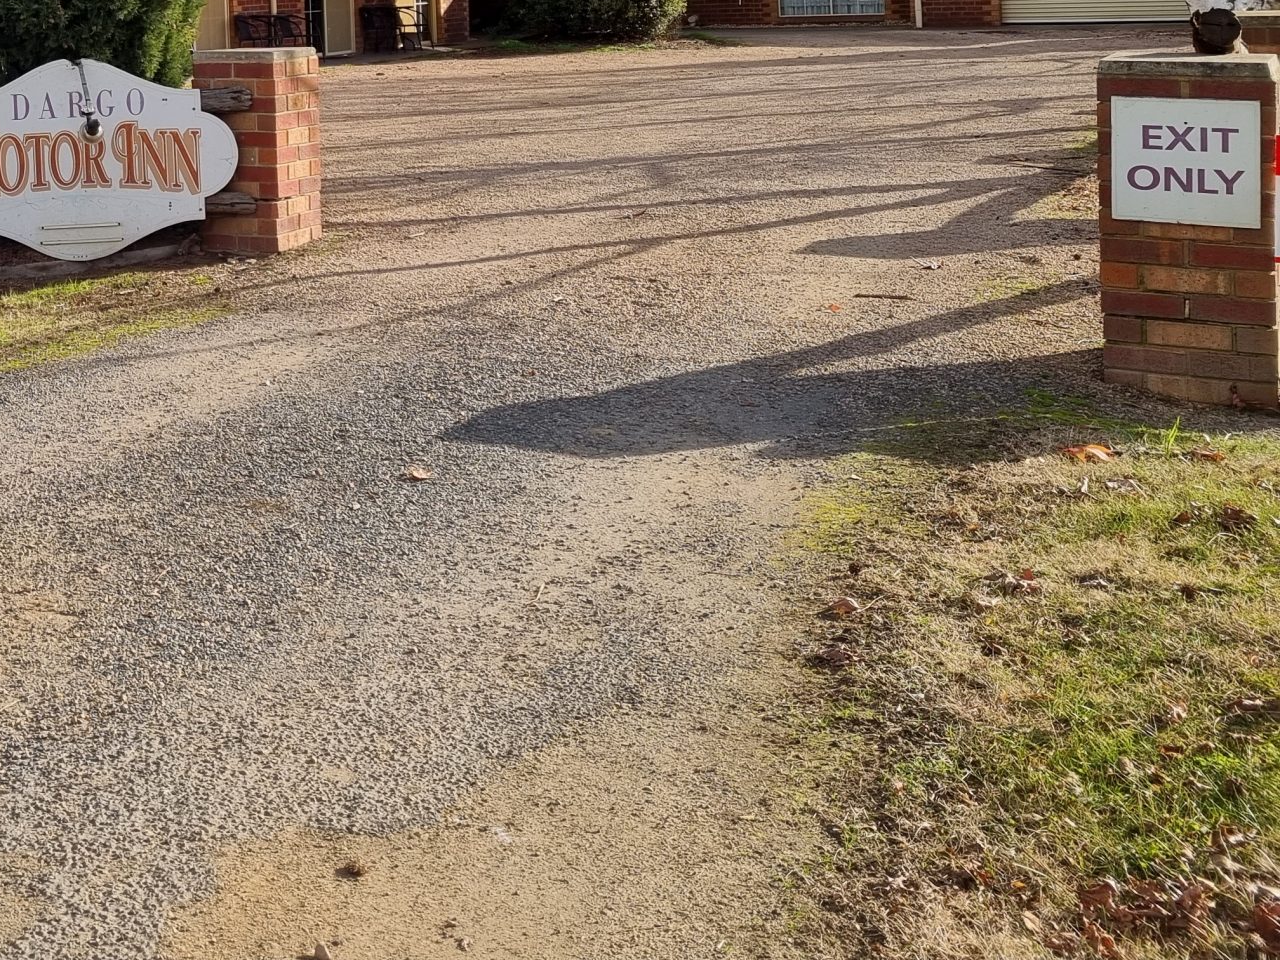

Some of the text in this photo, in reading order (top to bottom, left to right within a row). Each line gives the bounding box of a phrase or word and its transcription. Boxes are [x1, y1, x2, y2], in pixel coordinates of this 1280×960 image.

[11, 88, 145, 121] DARGO
[1141, 124, 1240, 153] EXIT
[111, 120, 202, 194] INN
[1127, 165, 1246, 195] ONLY
